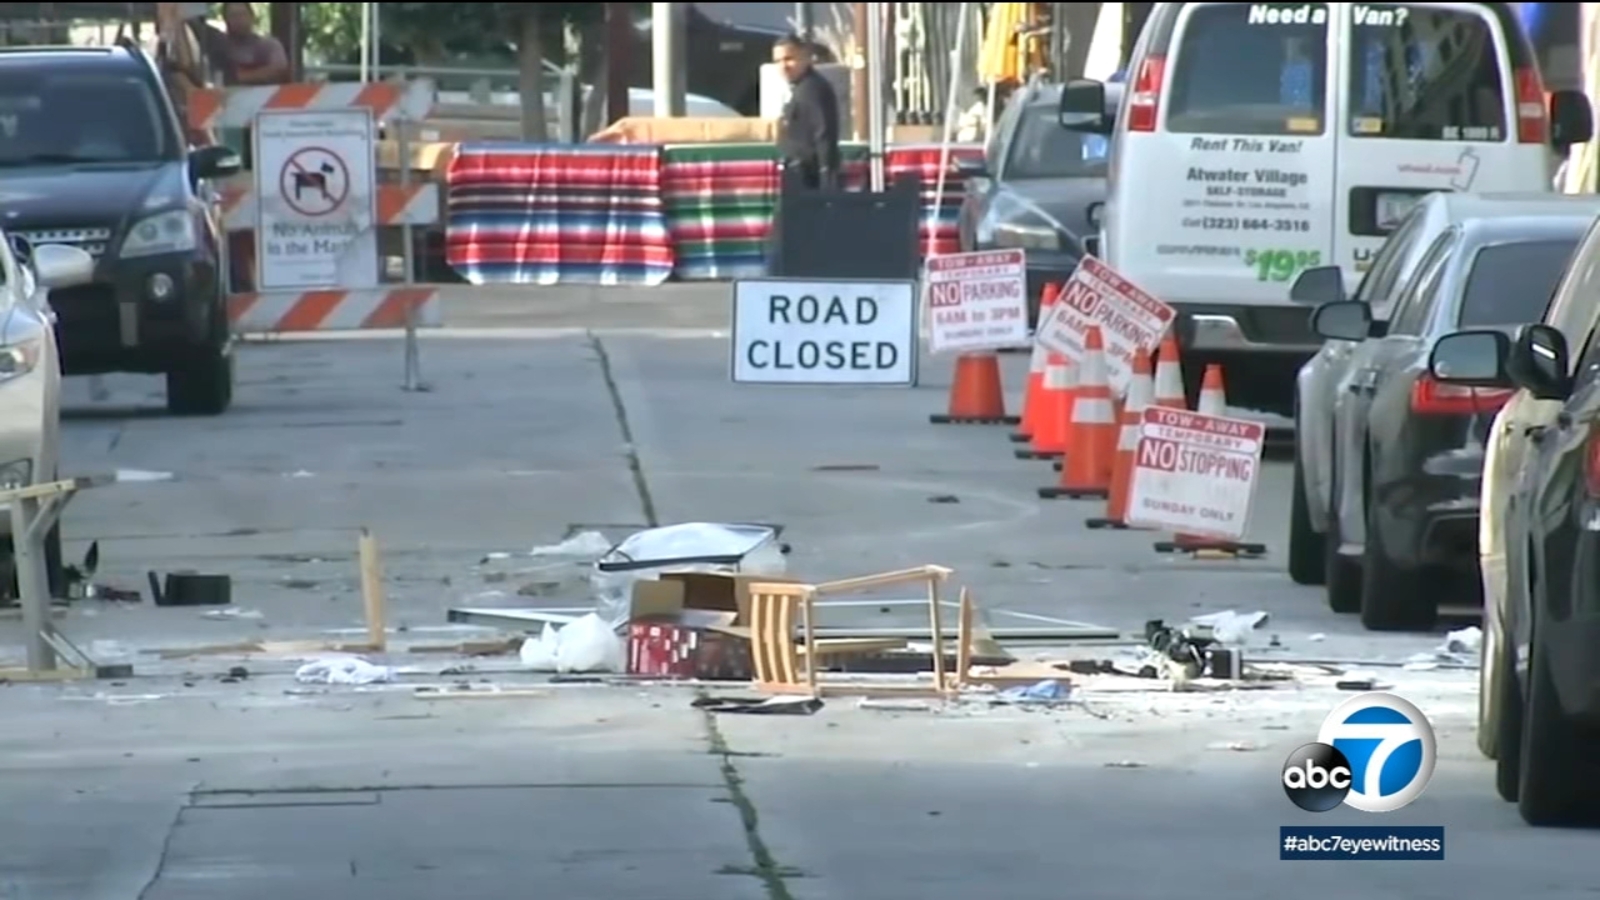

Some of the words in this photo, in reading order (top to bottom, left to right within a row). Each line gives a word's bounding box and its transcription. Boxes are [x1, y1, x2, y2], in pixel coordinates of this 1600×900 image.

[1249, 5, 1310, 24] Need
[1311, 9, 1326, 24] a
[1353, 6, 1408, 26] Van?
[1190, 137, 1228, 150] Rent
[1232, 138, 1264, 151] This
[1269, 140, 1303, 153] Van!
[1186, 167, 1249, 181] Atwater
[1254, 169, 1308, 187] Village
[273, 222, 295, 237] No
[1202, 216, 1239, 230] (323)
[932, 282, 960, 305] NO
[962, 280, 1020, 302] PARKING
[768, 295, 878, 325] ROAD
[1063, 281, 1099, 315] NO
[1095, 304, 1154, 347] PARKING
[747, 340, 898, 370] CLOSED
[1159, 426, 1243, 448] TEMPORARY
[1141, 439, 1176, 470] NO
[1179, 449, 1252, 482] STOPPING
[1143, 497, 1196, 515] SUNDAY
[1199, 507, 1235, 521] ONLY
